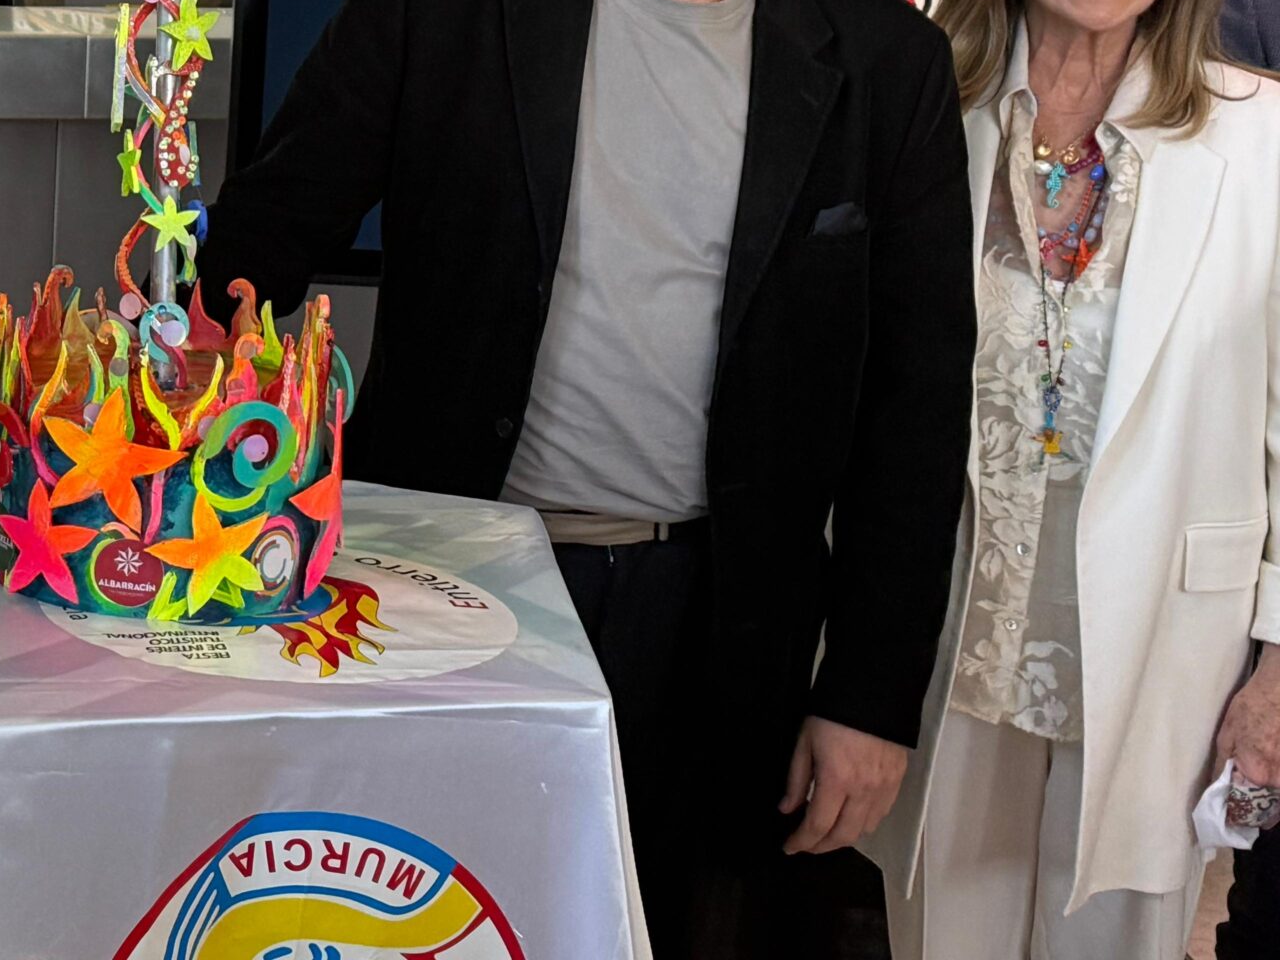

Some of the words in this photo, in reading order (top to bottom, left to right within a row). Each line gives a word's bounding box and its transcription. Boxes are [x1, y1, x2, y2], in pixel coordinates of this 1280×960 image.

[98, 578, 157, 592] ALBARRACÍN
[354, 556, 490, 610] Entierro
[208, 643, 228, 651] DE
[228, 838, 427, 901] MURCIA
